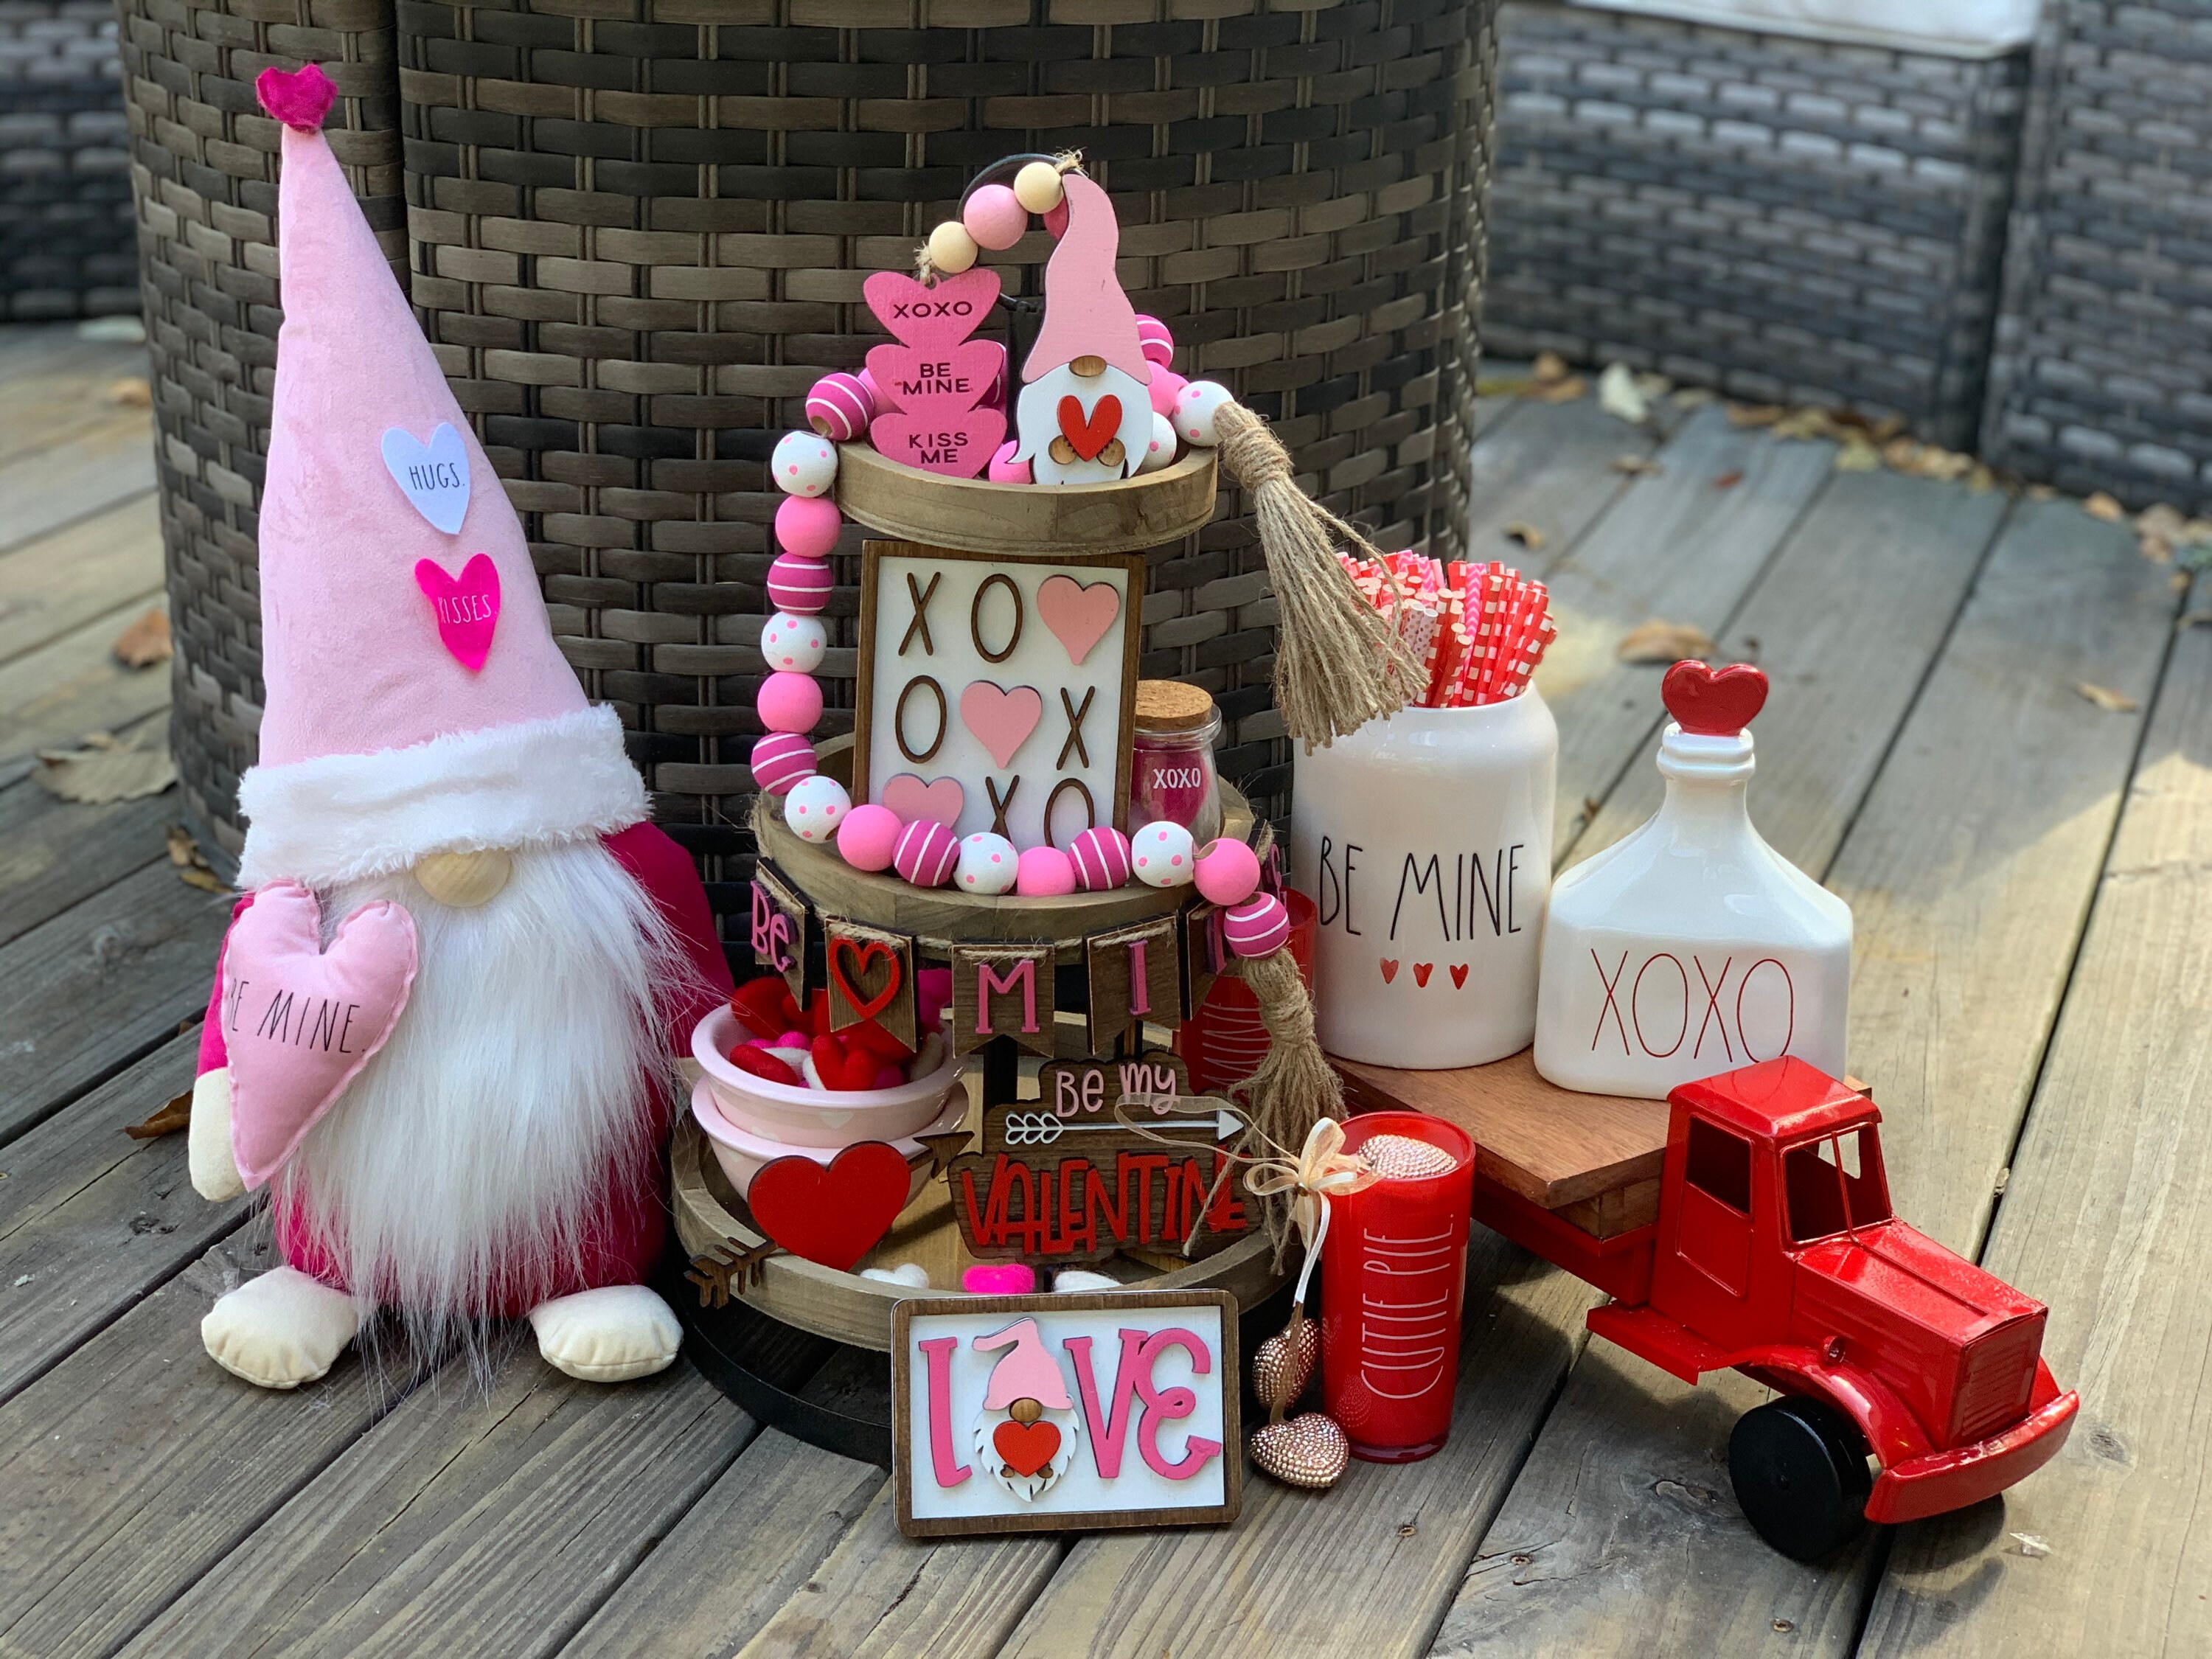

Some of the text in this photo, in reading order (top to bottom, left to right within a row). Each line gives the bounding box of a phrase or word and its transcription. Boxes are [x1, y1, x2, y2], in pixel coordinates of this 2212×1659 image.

[893, 301, 973, 319] XOXO
[919, 362, 951, 378] BE
[902, 378, 970, 395] MINE
[908, 431, 969, 449] KISS
[920, 448, 959, 465] ME
[1152, 767, 1202, 790] XOXO
[1318, 835, 1525, 942] BE MINE
[1590, 947, 1795, 1064] XOXO
[1055, 1068, 1105, 1118] Be
